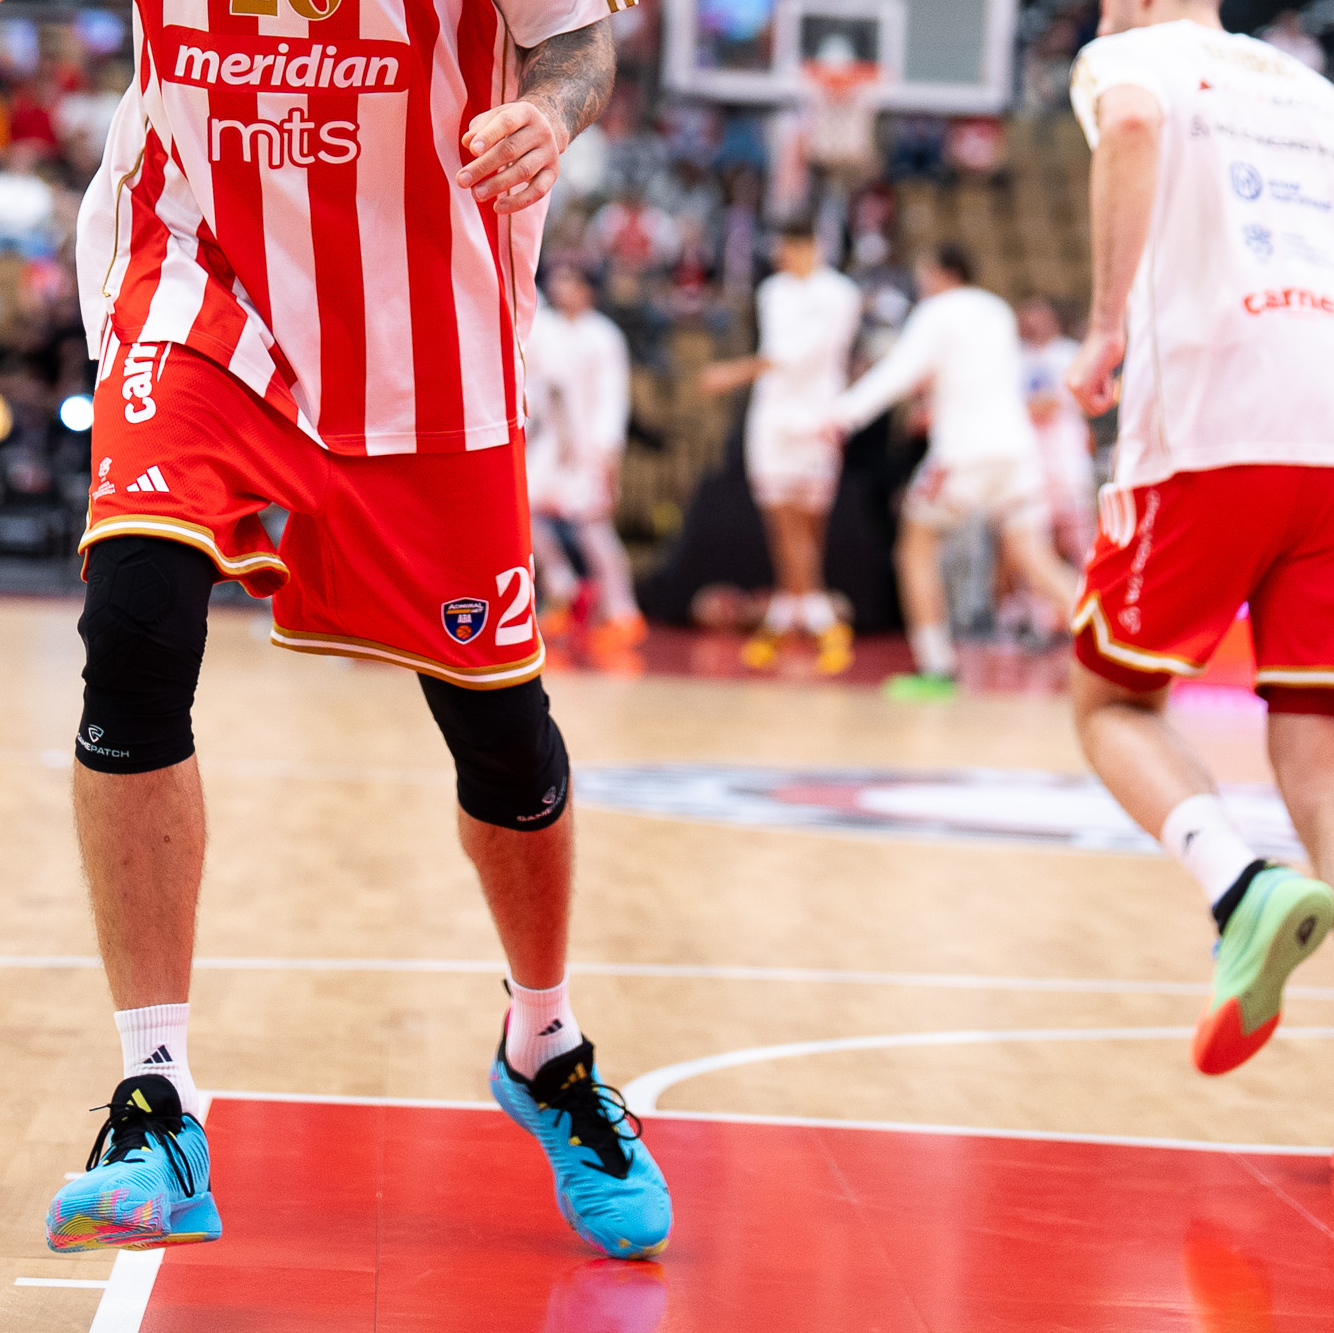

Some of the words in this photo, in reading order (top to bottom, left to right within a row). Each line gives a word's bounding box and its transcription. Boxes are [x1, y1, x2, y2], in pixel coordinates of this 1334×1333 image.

[174, 42, 399, 89] meridian
[210, 109, 359, 167] mts
[448, 602, 484, 610] ADMIRAL
